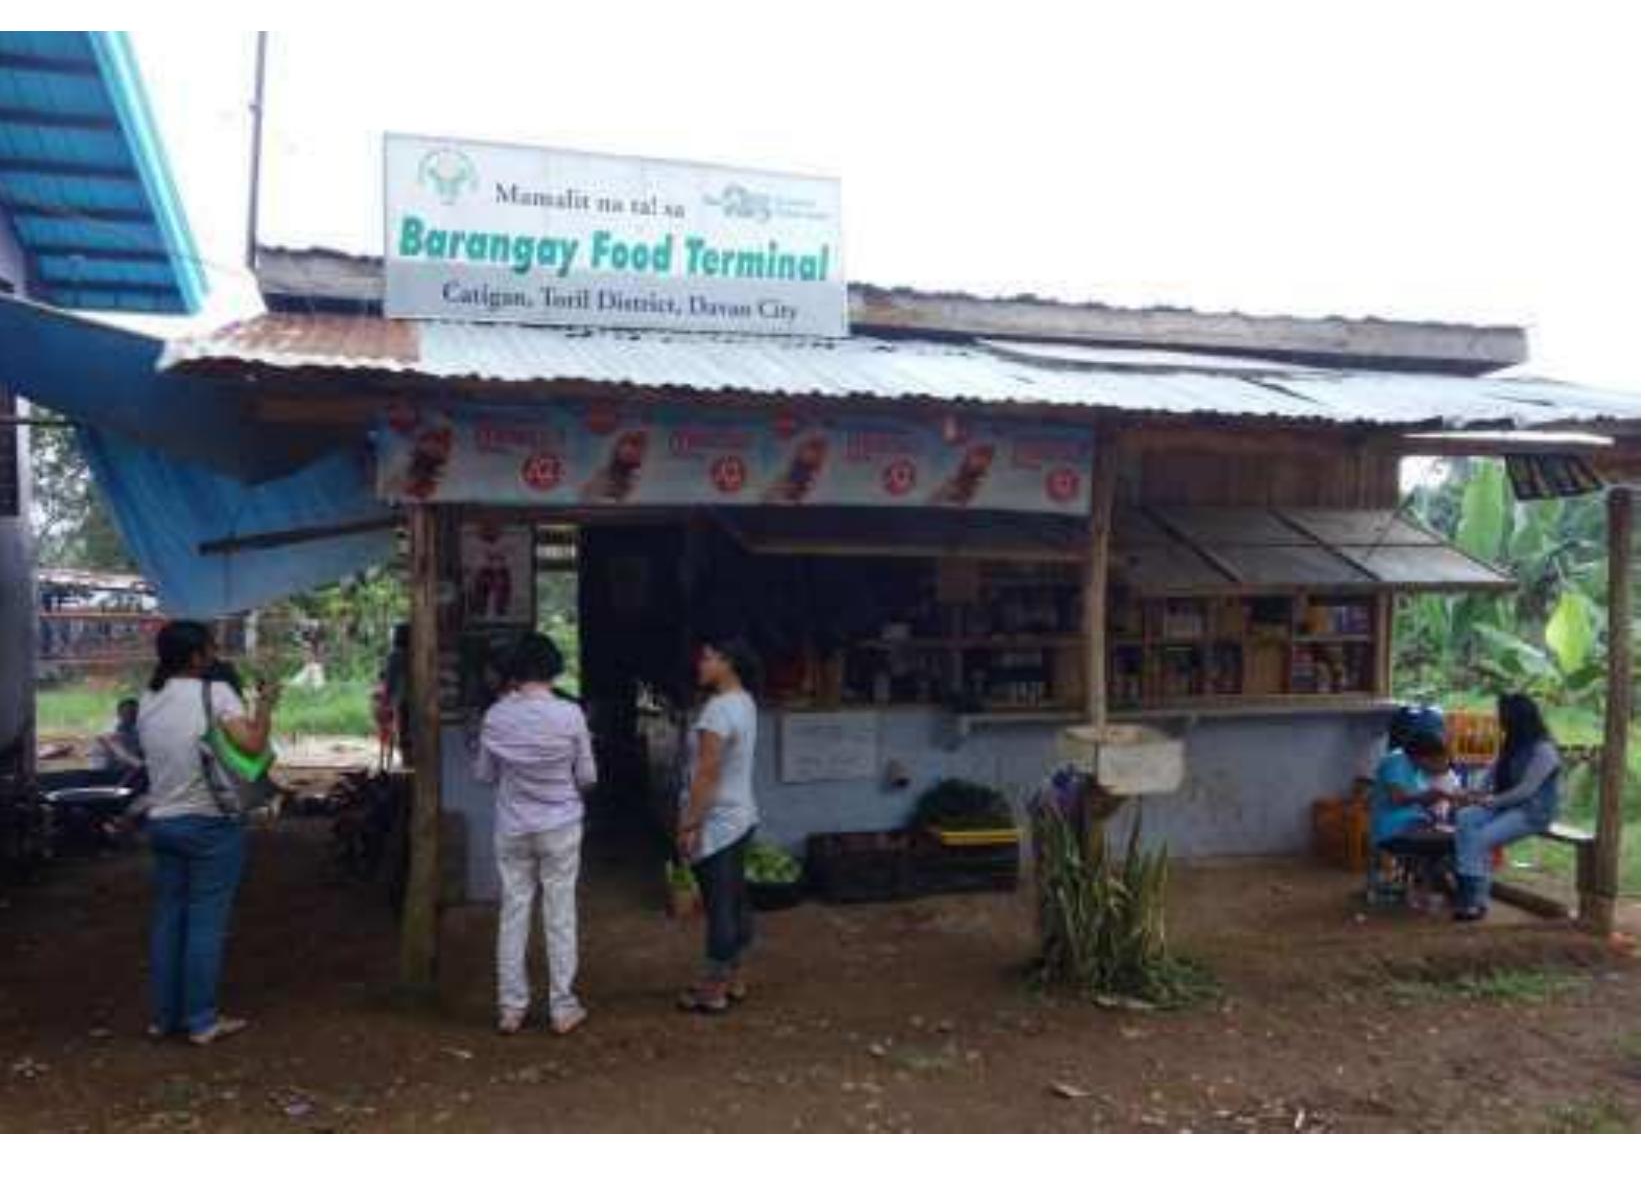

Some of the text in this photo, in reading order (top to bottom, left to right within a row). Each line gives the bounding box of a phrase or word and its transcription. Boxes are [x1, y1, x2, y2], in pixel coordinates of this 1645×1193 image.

[400, 217, 829, 282] Barangay Food Terminal
[598, 288, 681, 317] District,
[757, 300, 798, 324] City
